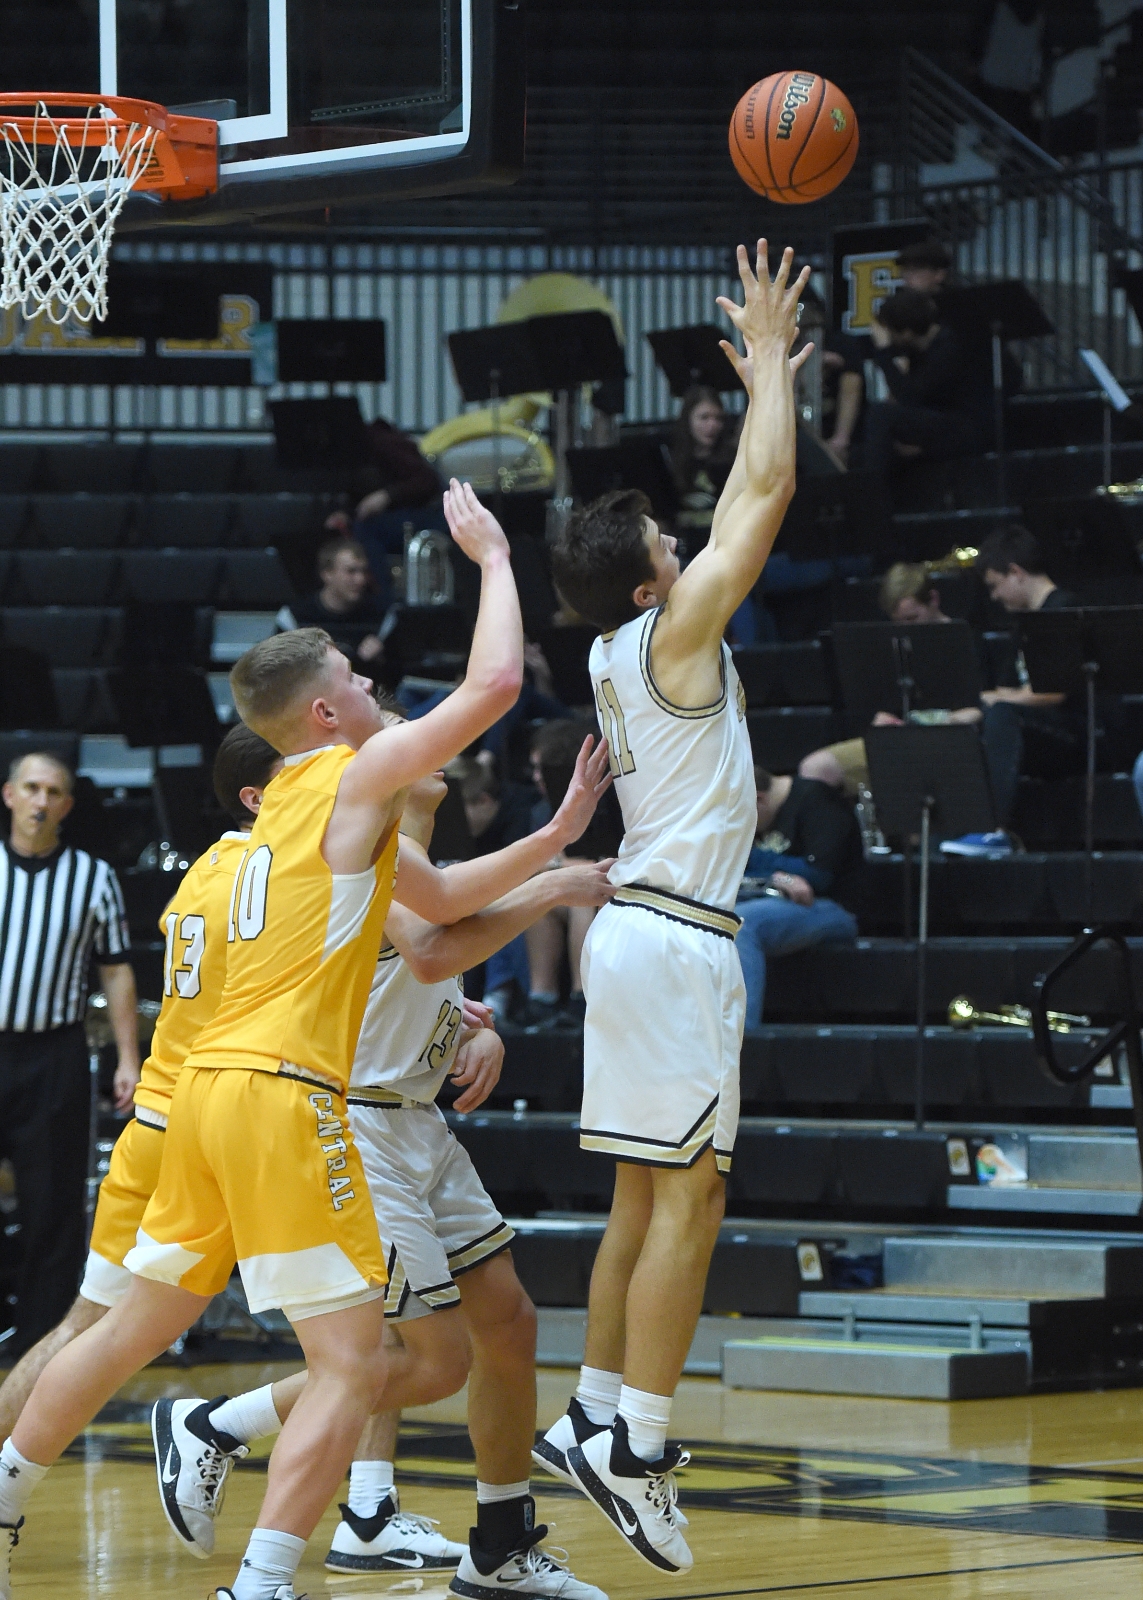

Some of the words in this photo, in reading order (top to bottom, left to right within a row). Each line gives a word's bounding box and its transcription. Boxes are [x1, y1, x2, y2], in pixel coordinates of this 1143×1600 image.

[776, 73, 815, 140] Wilson
[595, 677, 637, 780] 11
[227, 844, 274, 944] 10
[164, 911, 206, 1000] 13
[308, 1092, 356, 1212] CENTRAL
